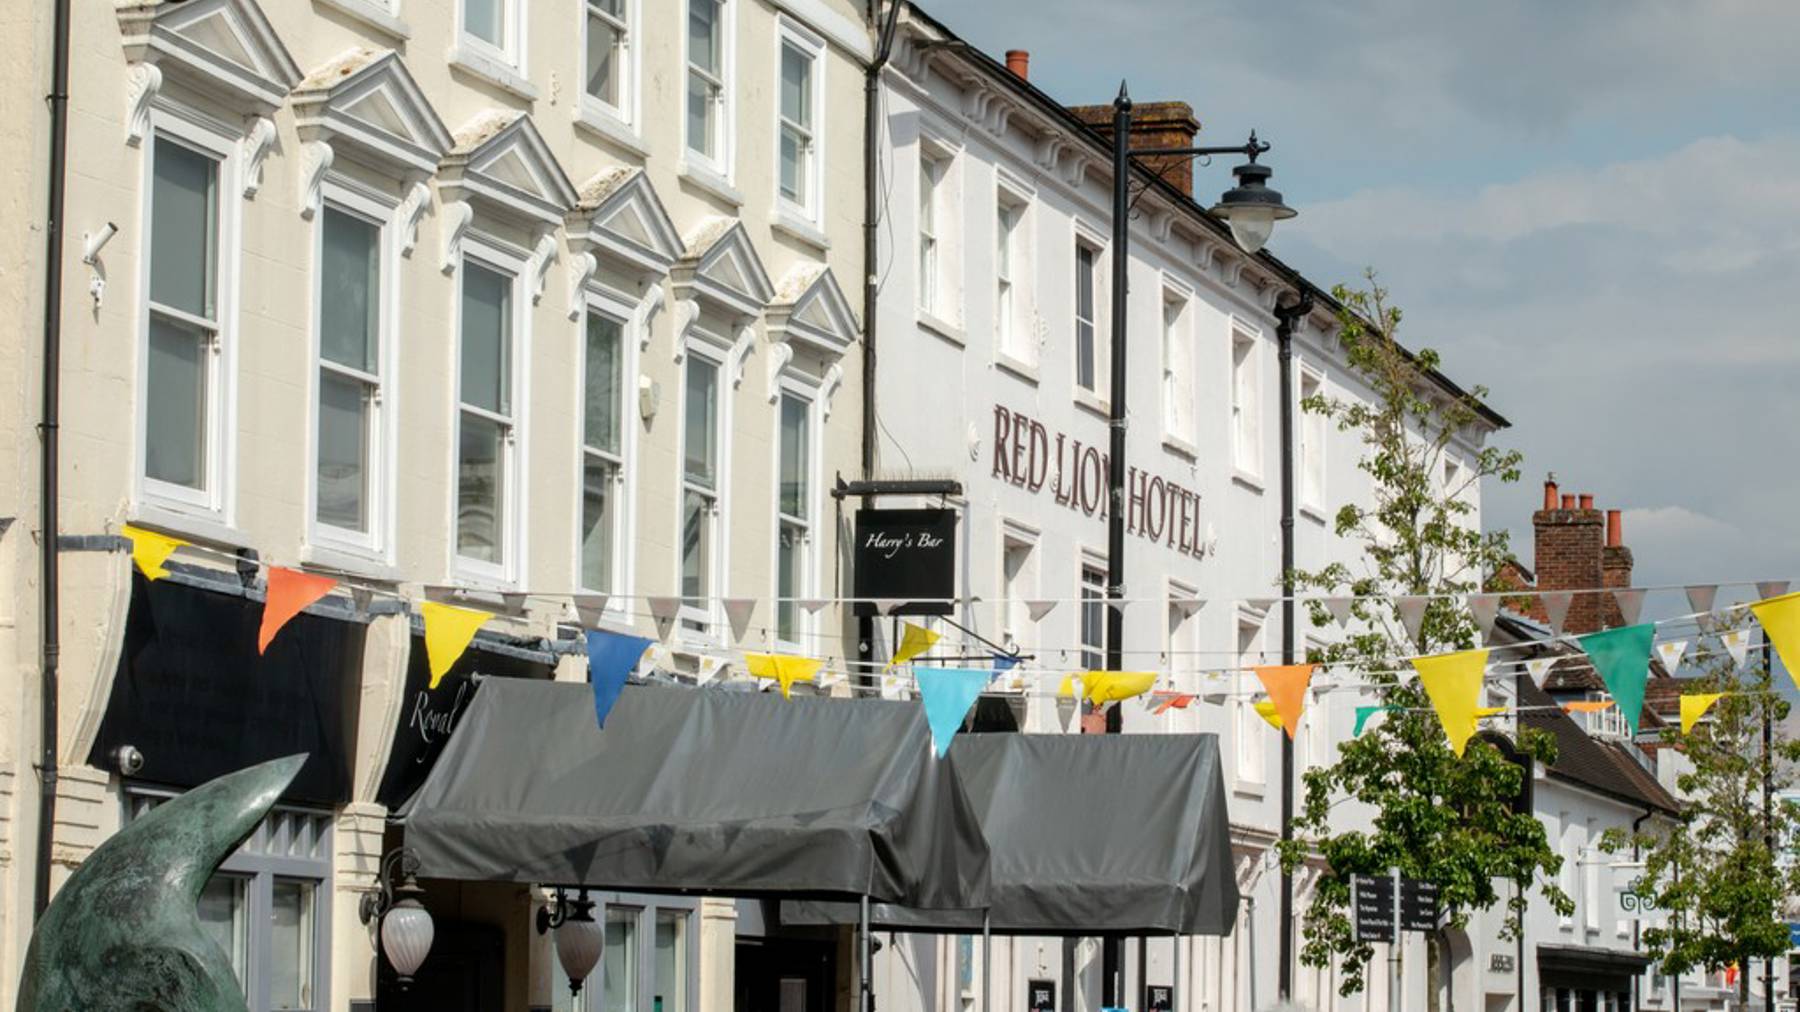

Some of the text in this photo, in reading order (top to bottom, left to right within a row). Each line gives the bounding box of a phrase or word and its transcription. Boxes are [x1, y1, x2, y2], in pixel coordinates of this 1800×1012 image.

[991, 403, 1049, 494] RED
[1126, 465, 1205, 560] HOTEL
[865, 531, 944, 560] Harry's Bar
